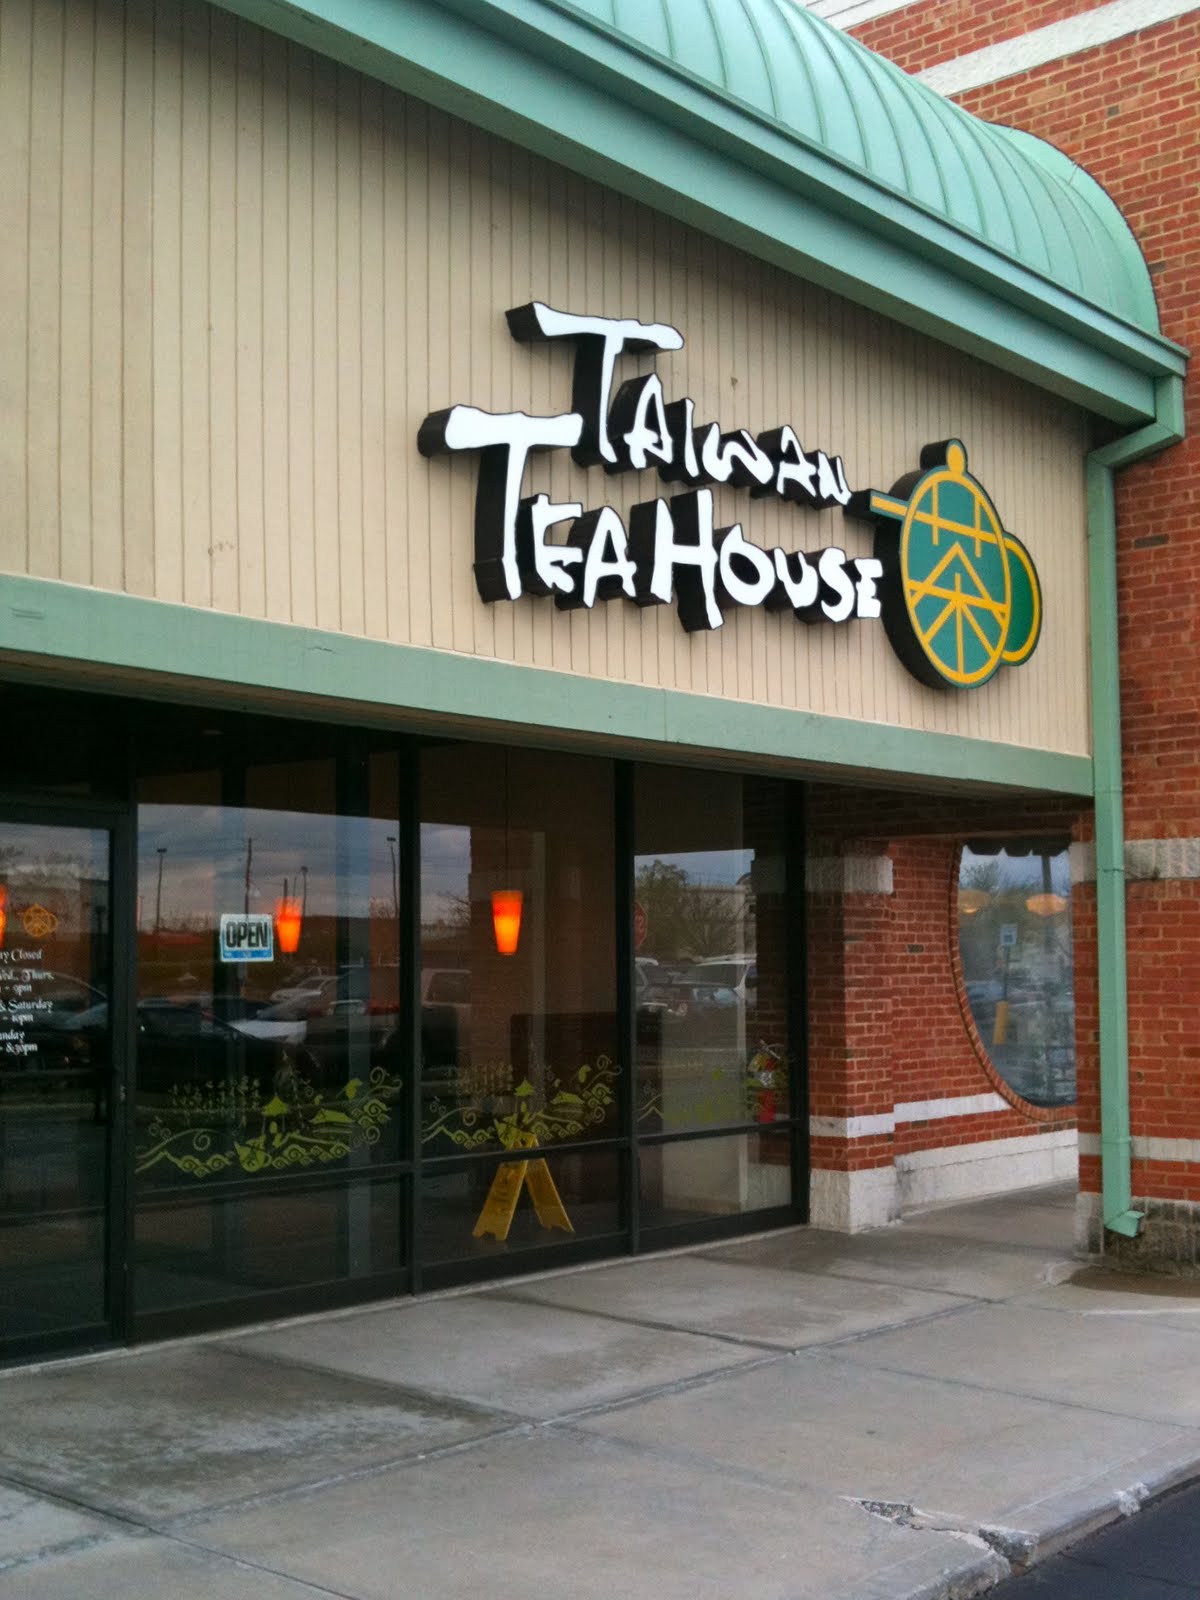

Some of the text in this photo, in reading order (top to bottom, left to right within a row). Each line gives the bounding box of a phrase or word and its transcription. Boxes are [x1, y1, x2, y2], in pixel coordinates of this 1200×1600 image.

[531, 301, 852, 505] TAIWAN
[226, 921, 268, 948] OPEN
[11, 948, 43, 961] Closed
[8, 1000, 53, 1014] Saturday
